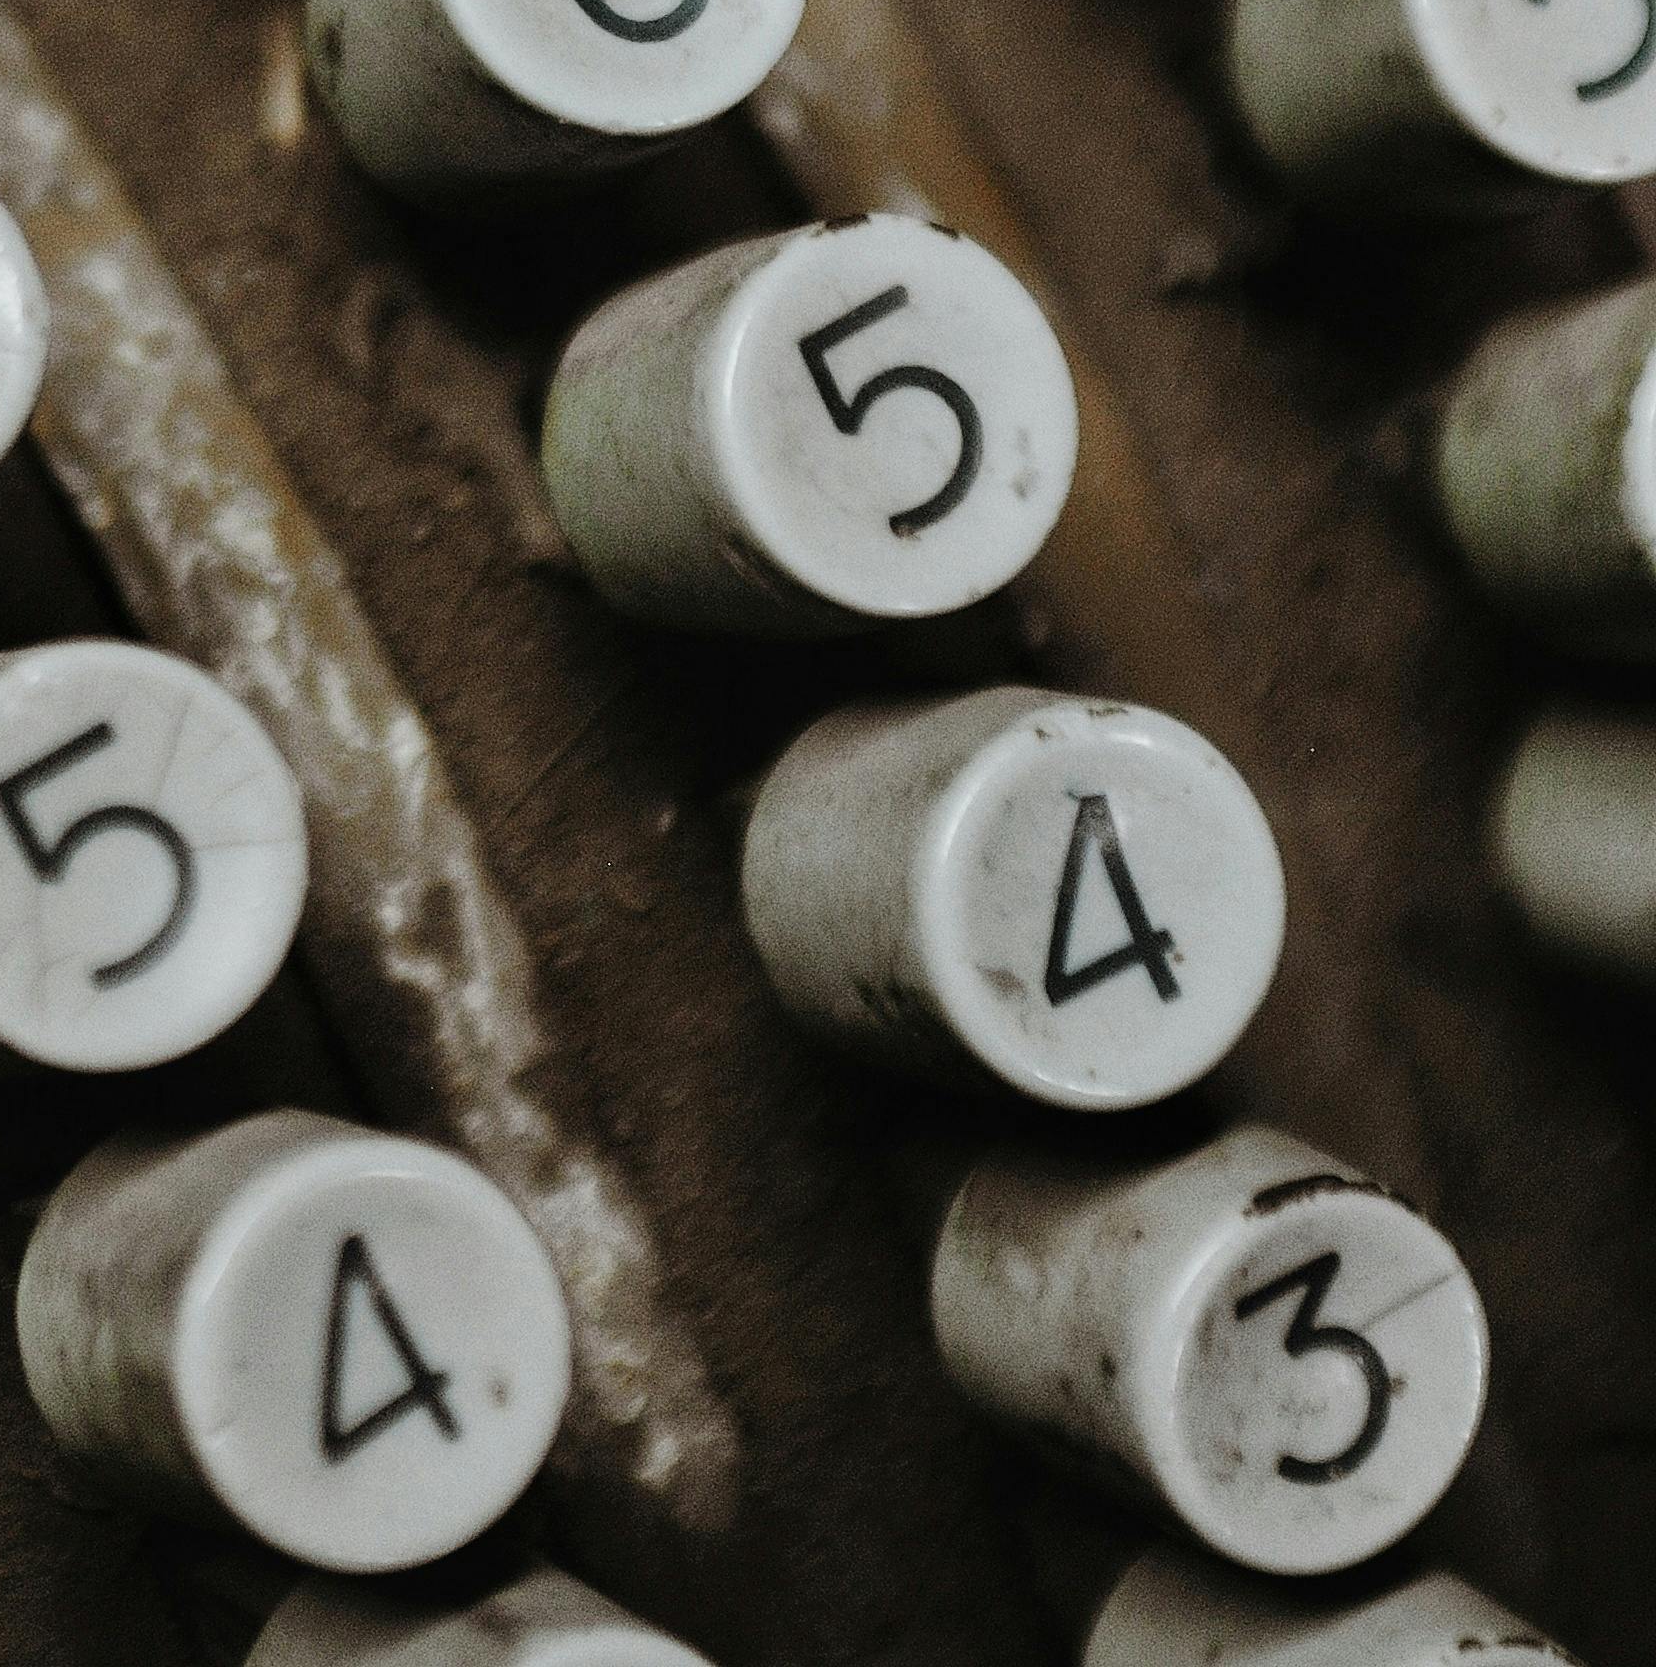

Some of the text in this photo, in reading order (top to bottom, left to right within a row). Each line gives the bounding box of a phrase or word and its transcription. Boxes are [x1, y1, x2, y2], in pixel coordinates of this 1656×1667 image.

[797, 287, 981, 537] 5
[1041, 794, 1178, 1007] 4
[317, 1232, 457, 1464] 4
[1227, 1248, 1398, 1486] 3
